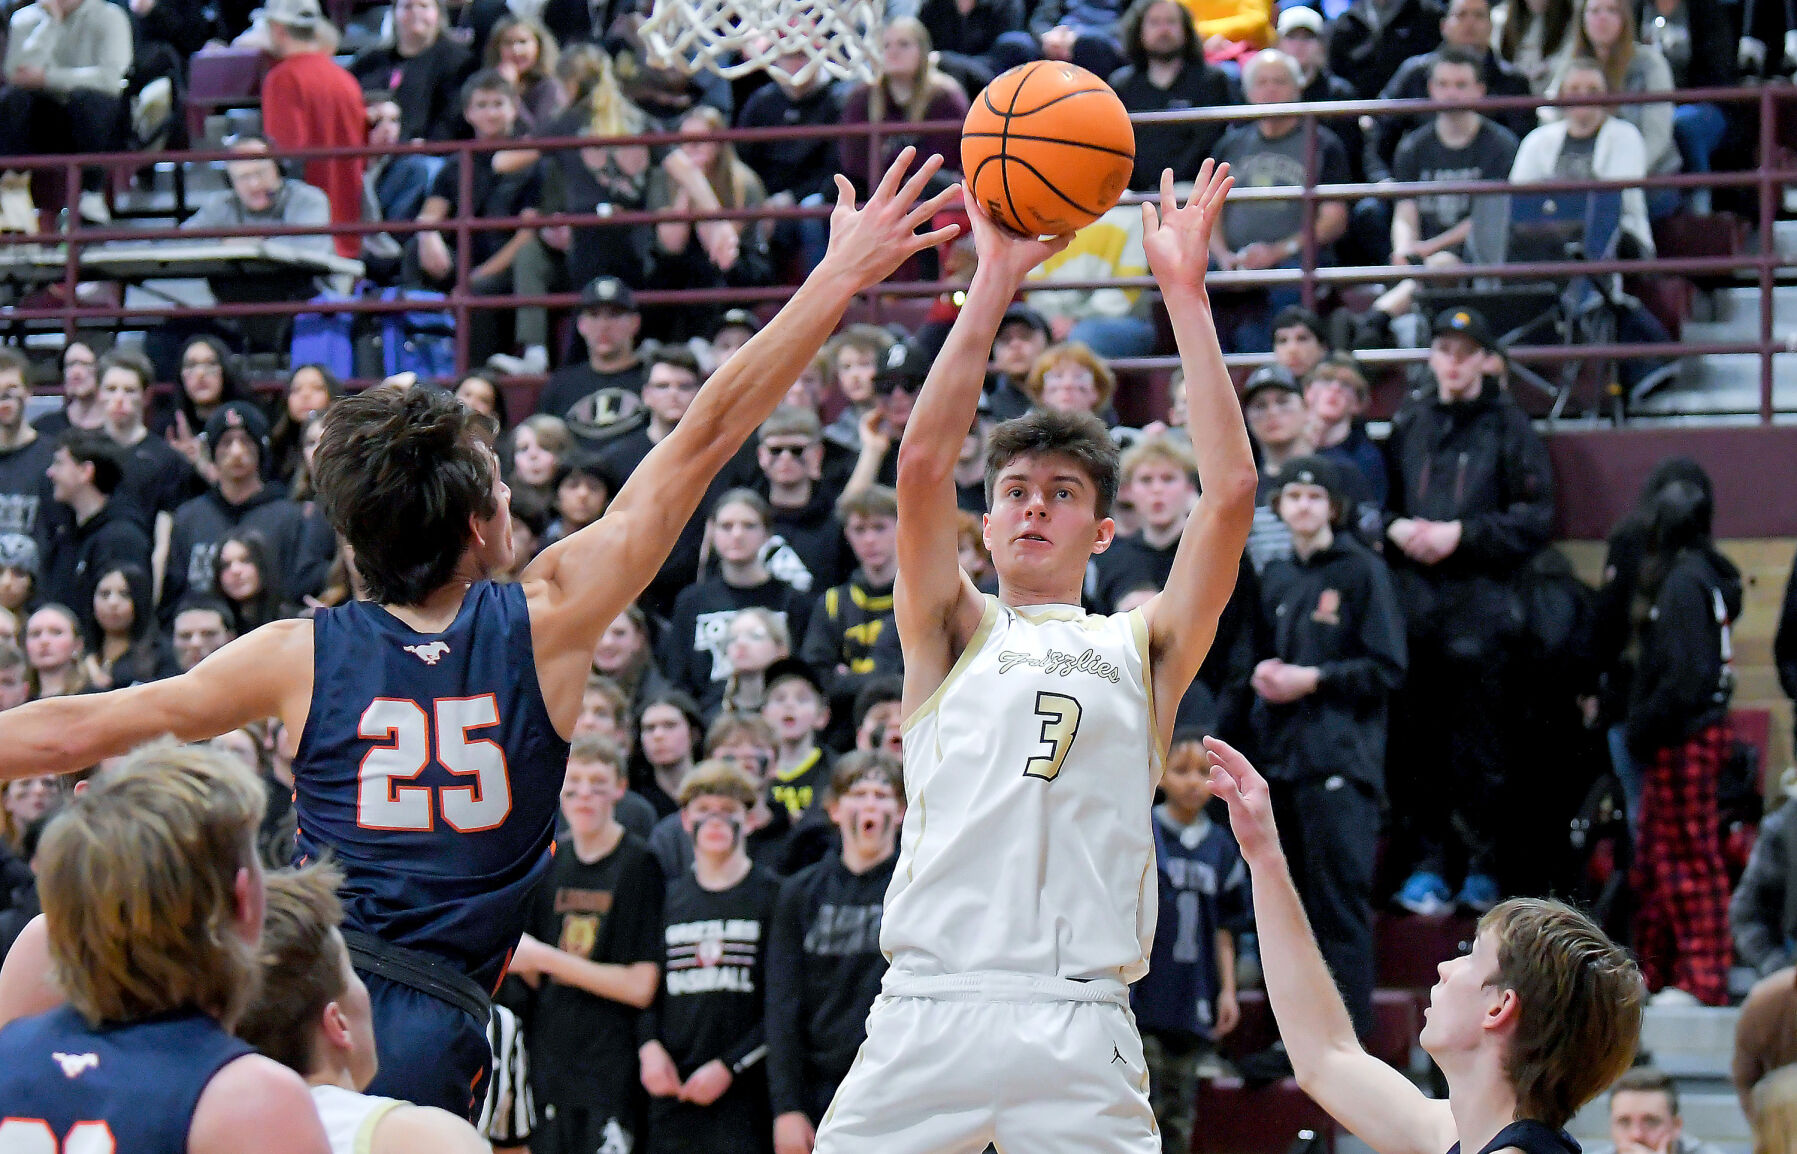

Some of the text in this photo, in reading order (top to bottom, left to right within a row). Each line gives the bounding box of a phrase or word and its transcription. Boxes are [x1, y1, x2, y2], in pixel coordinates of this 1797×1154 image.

[999, 649, 1120, 683] Grizzlies
[356, 692, 512, 833] 25
[1023, 691, 1082, 782] 3
